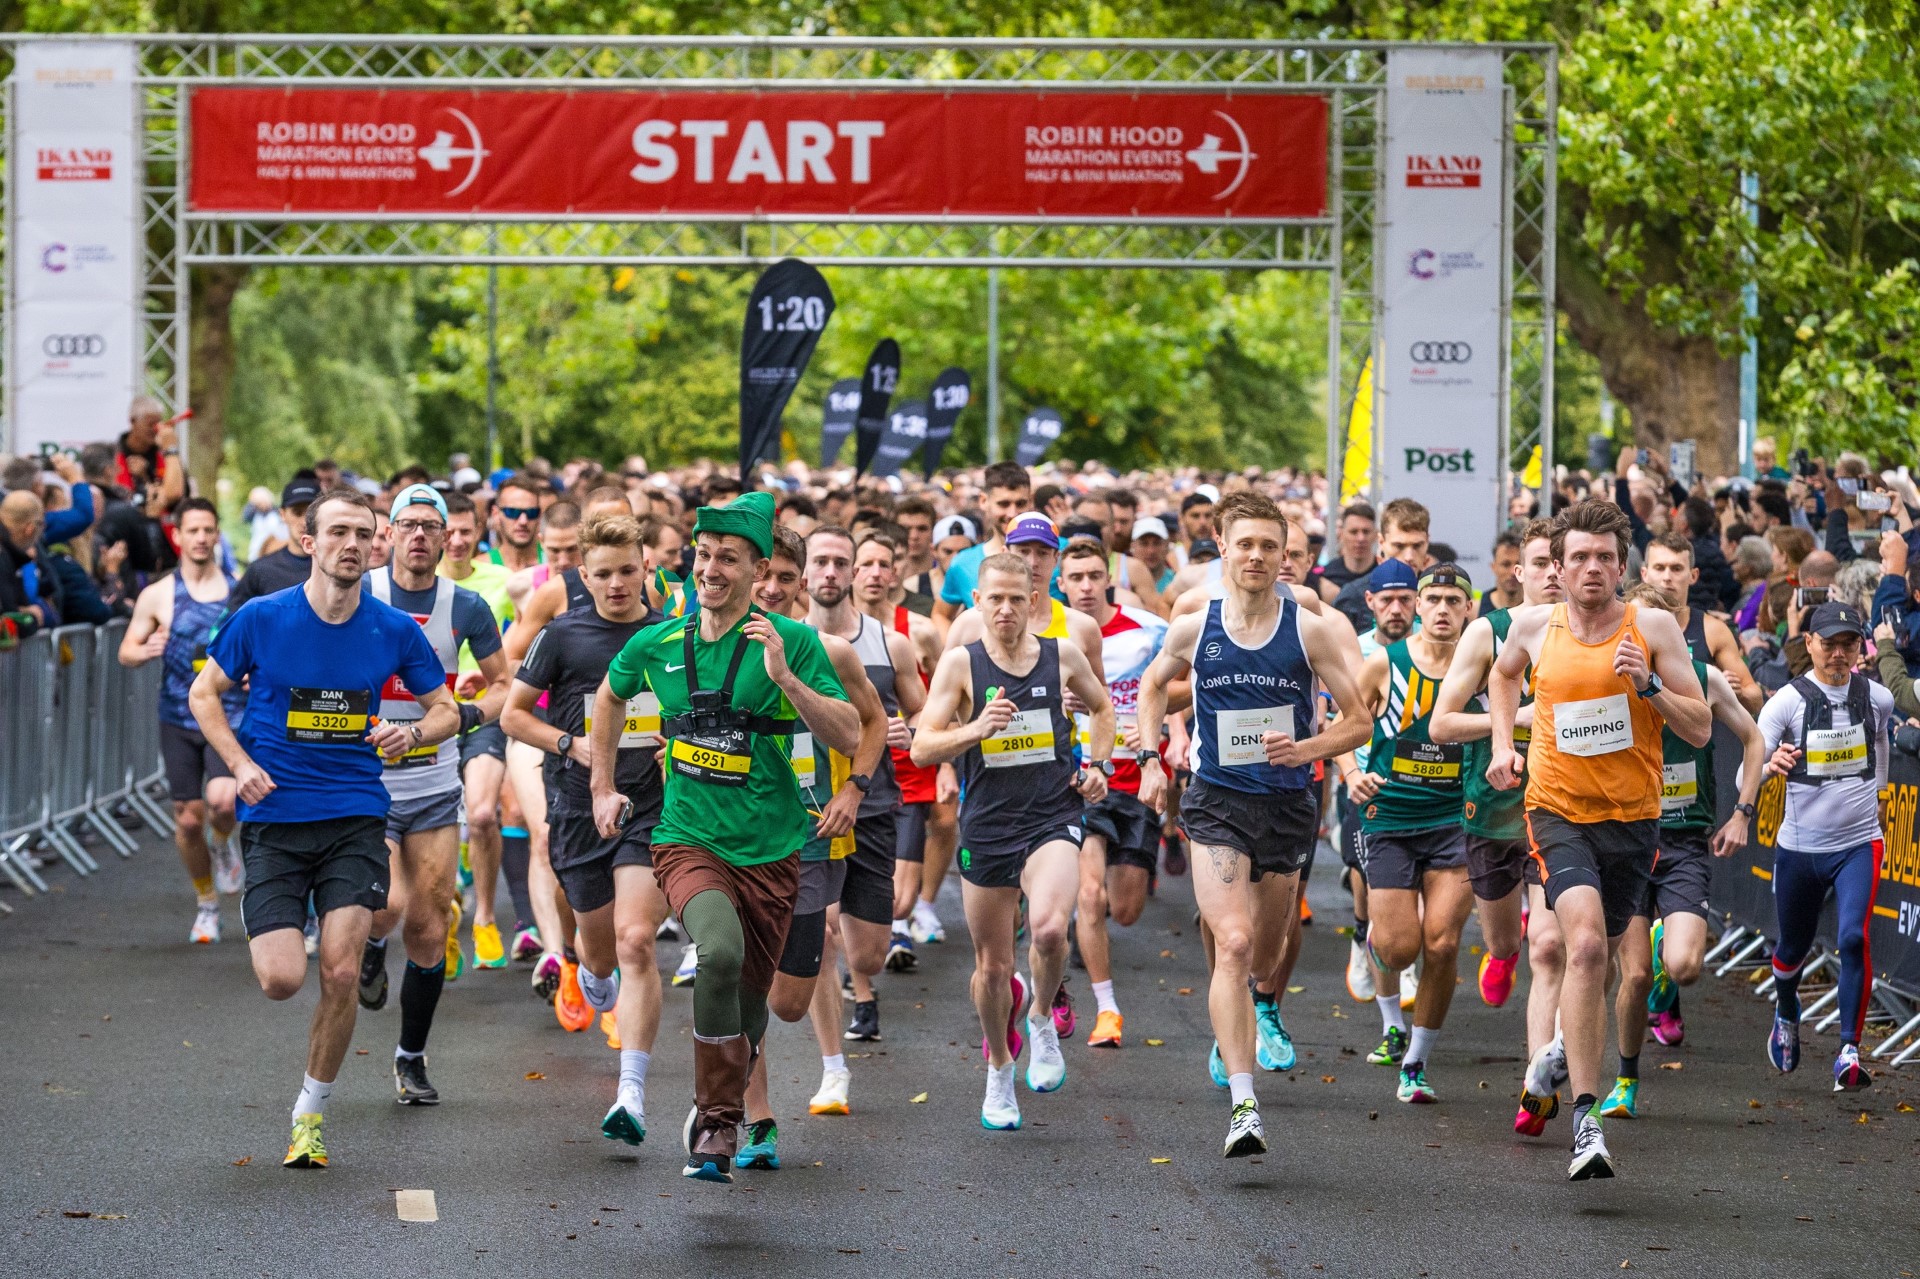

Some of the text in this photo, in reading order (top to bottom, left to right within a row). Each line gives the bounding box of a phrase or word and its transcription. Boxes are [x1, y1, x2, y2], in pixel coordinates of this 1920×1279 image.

[257, 122, 416, 144] ROBIN HOOD
[1025, 126, 1184, 148] ROBIN HOOD
[38, 149, 112, 164] IKANO
[257, 145, 416, 164] MARATHON EVENTS
[630, 119, 885, 183] START
[1025, 149, 1184, 166] MARATHON EVENTS
[1407, 155, 1482, 171] IKANO
[1025, 169, 1059, 183] HALF
[1060, 169, 1072, 183] &
[1106, 169, 1184, 183] MARATHON
[758, 296, 826, 332] 1:20
[1404, 447, 1475, 473] Post
[1201, 674, 1300, 690] LONG EATON R.C.
[321, 690, 343, 699] DAN
[312, 715, 348, 728] 3320
[1561, 720, 1625, 739] CHIPPING
[1002, 737, 1034, 751] 2810
[1421, 743, 1440, 752] TOM
[692, 750, 725, 768] 6951
[1825, 750, 1854, 762] 3648
[1412, 764, 1443, 775] 5880
[1880, 782, 1920, 887] GOL
